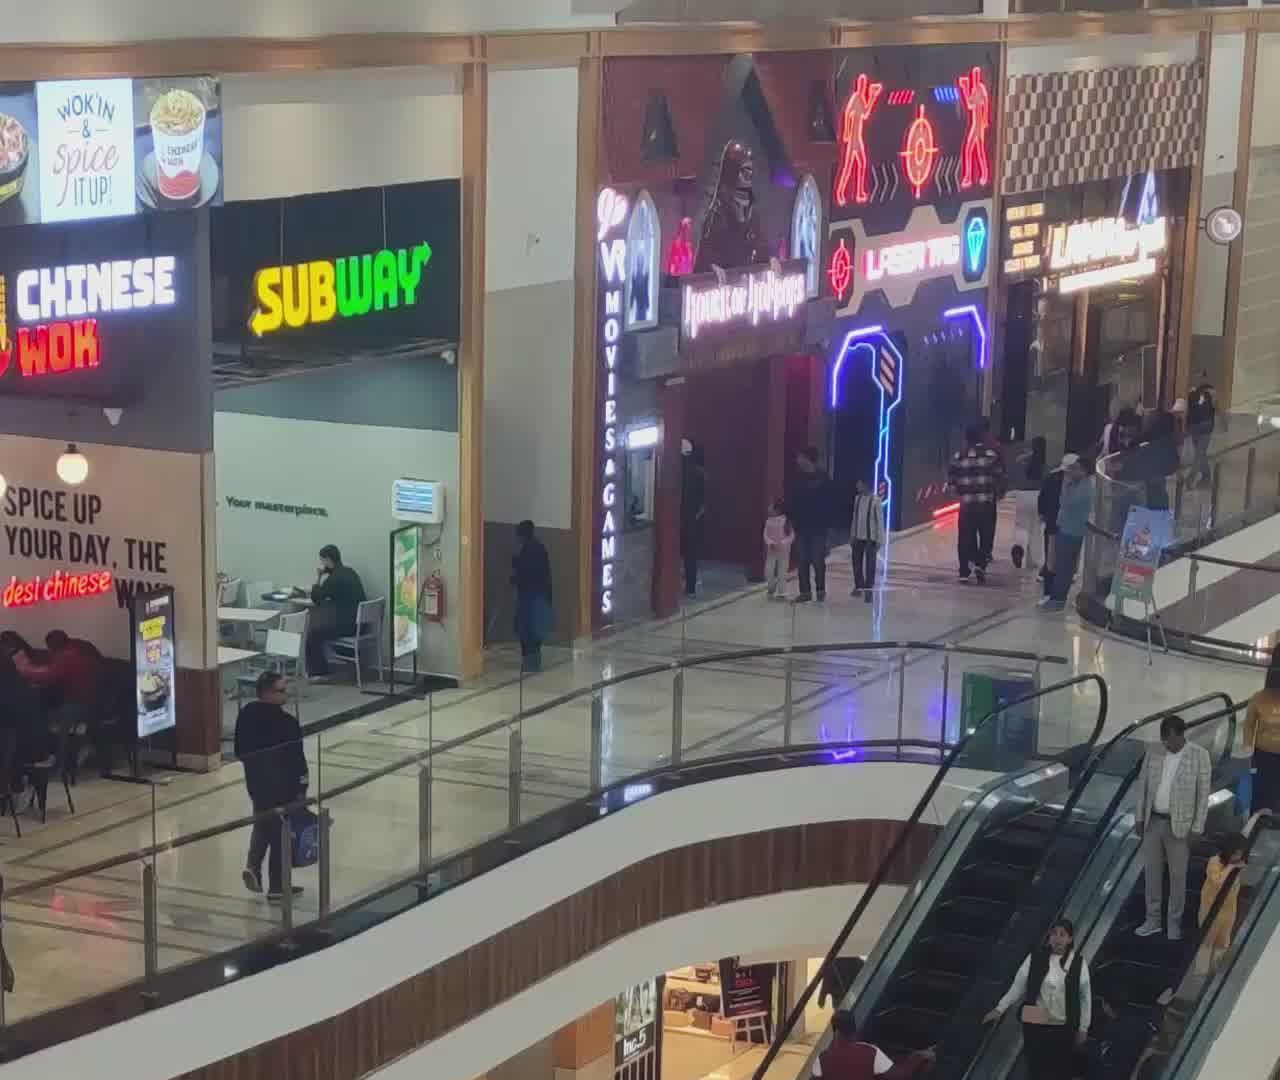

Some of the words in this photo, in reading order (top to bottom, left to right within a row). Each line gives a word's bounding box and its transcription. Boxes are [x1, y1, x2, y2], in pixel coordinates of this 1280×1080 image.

[56, 92, 116, 121] WOK'IN
[81, 120, 92, 140] &
[53, 142, 119, 207] Spice
[73, 179, 88, 206] IT
[89, 175, 114, 207] UP!
[16, 256, 176, 321] CHINESE
[248, 241, 432, 337] SUBWAY
[17, 318, 102, 377] WOK
[604, 292, 620, 450] MOVIES
[4, 486, 66, 525] SPICE
[73, 494, 102, 523] UP
[226, 496, 251, 509] Your
[3, 525, 63, 561] YOUR
[69, 529, 118, 570] DAY,
[127, 538, 167, 574] THE
[601, 483, 616, 614] GAMES
[1, 579, 41, 607] desi
[43, 571, 112, 602] chinese
[624, 1028, 647, 1056] Inc.5
